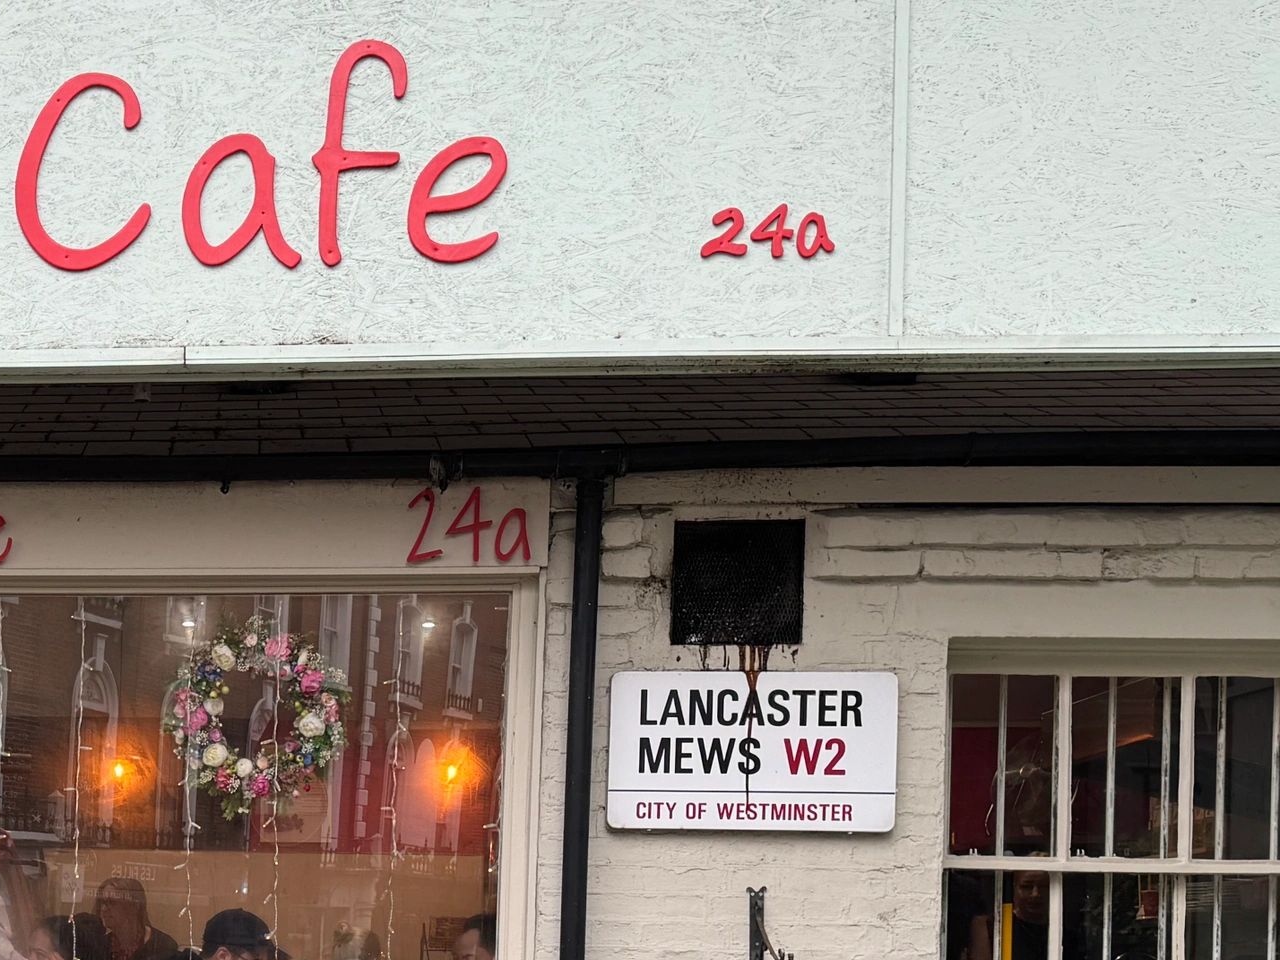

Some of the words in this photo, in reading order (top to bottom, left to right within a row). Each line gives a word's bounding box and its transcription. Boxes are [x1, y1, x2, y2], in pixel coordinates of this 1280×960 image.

[15, 40, 510, 274] Cafe
[700, 203, 835, 259] 24a
[406, 486, 531, 564] 24a
[639, 688, 863, 727] LANCASTER
[638, 737, 762, 776] MEWS
[783, 738, 847, 776] W2
[635, 802, 677, 820] CITY
[685, 802, 708, 820] OF
[716, 803, 853, 821] WESTMINSTER
